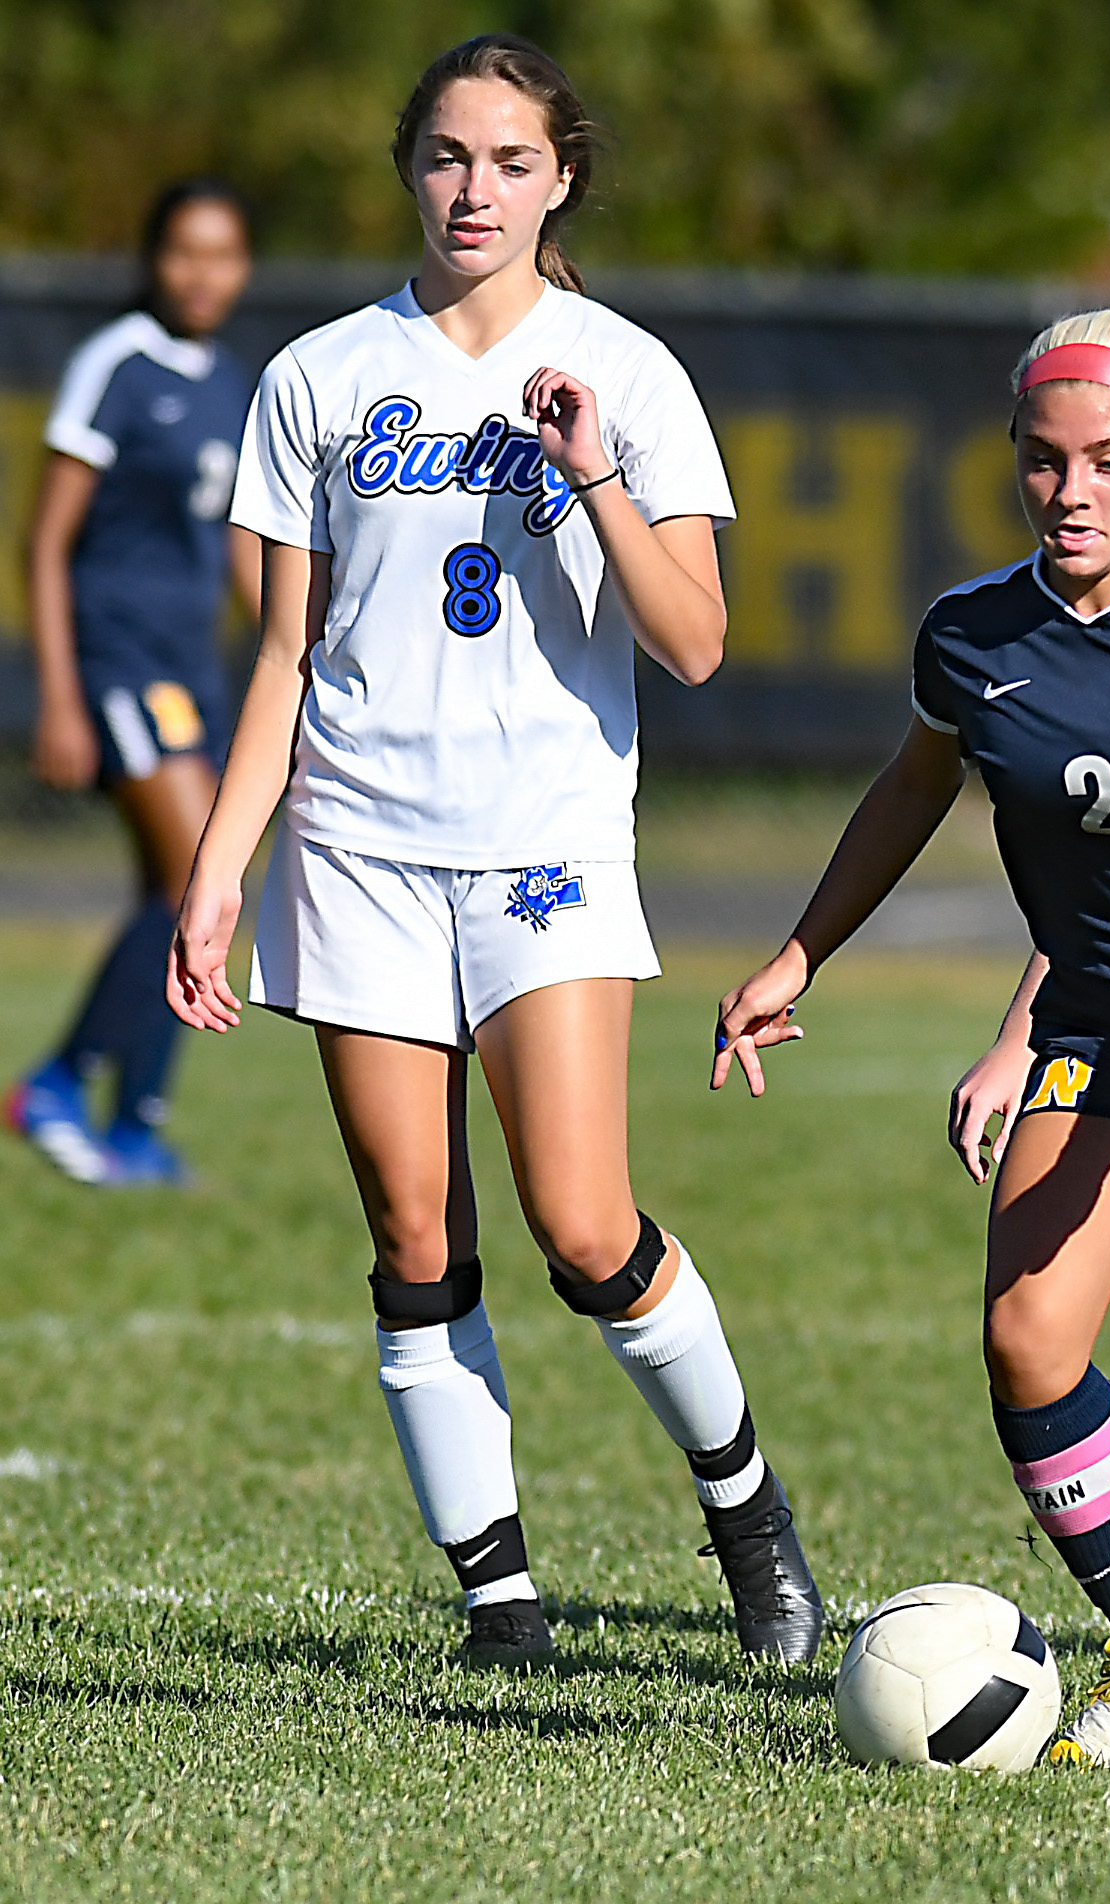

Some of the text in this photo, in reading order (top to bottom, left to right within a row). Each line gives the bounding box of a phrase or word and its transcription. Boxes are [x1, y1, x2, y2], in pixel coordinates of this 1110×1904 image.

[346, 394, 579, 538] Ewing
[443, 542, 501, 638] 8
[1022, 1055, 1096, 1113] N
